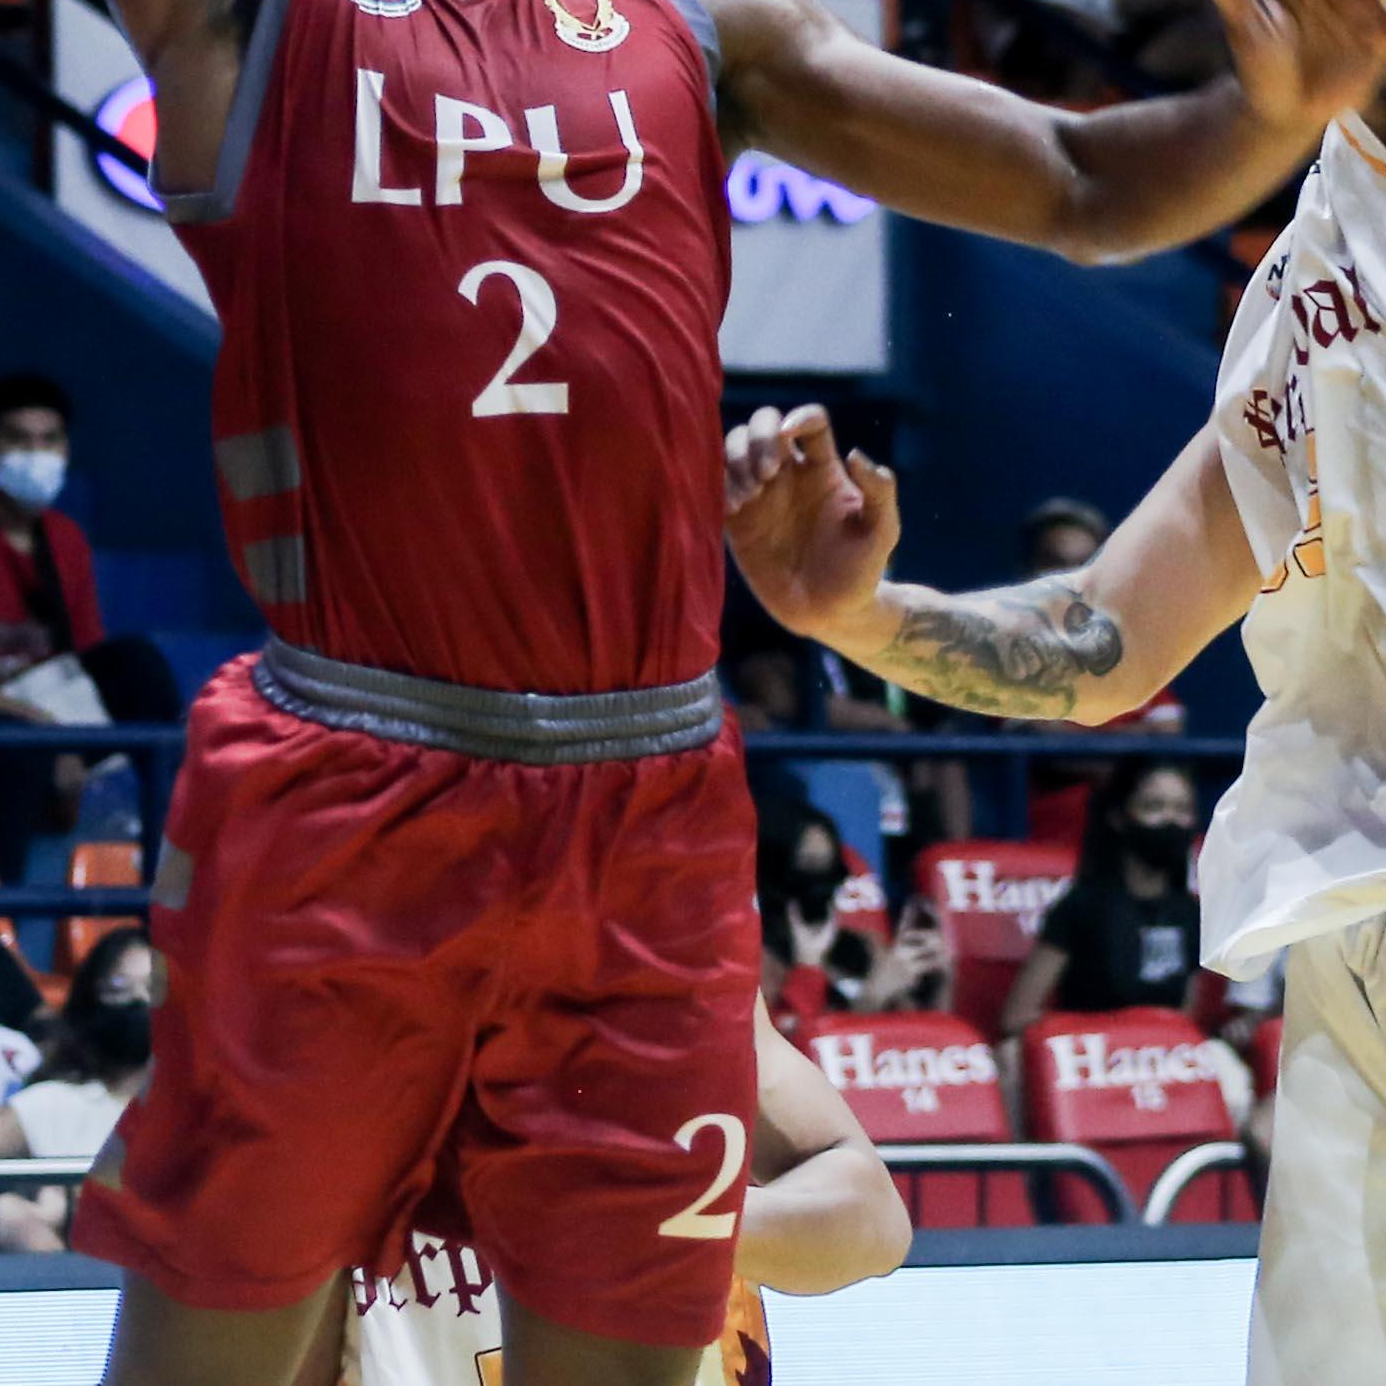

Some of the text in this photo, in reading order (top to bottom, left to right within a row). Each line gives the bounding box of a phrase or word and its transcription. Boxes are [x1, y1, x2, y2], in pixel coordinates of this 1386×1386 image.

[352, 68, 643, 213] LPU
[457, 260, 570, 418] 2
[812, 1033, 998, 1089] Hanes
[657, 1112, 748, 1239] 2
